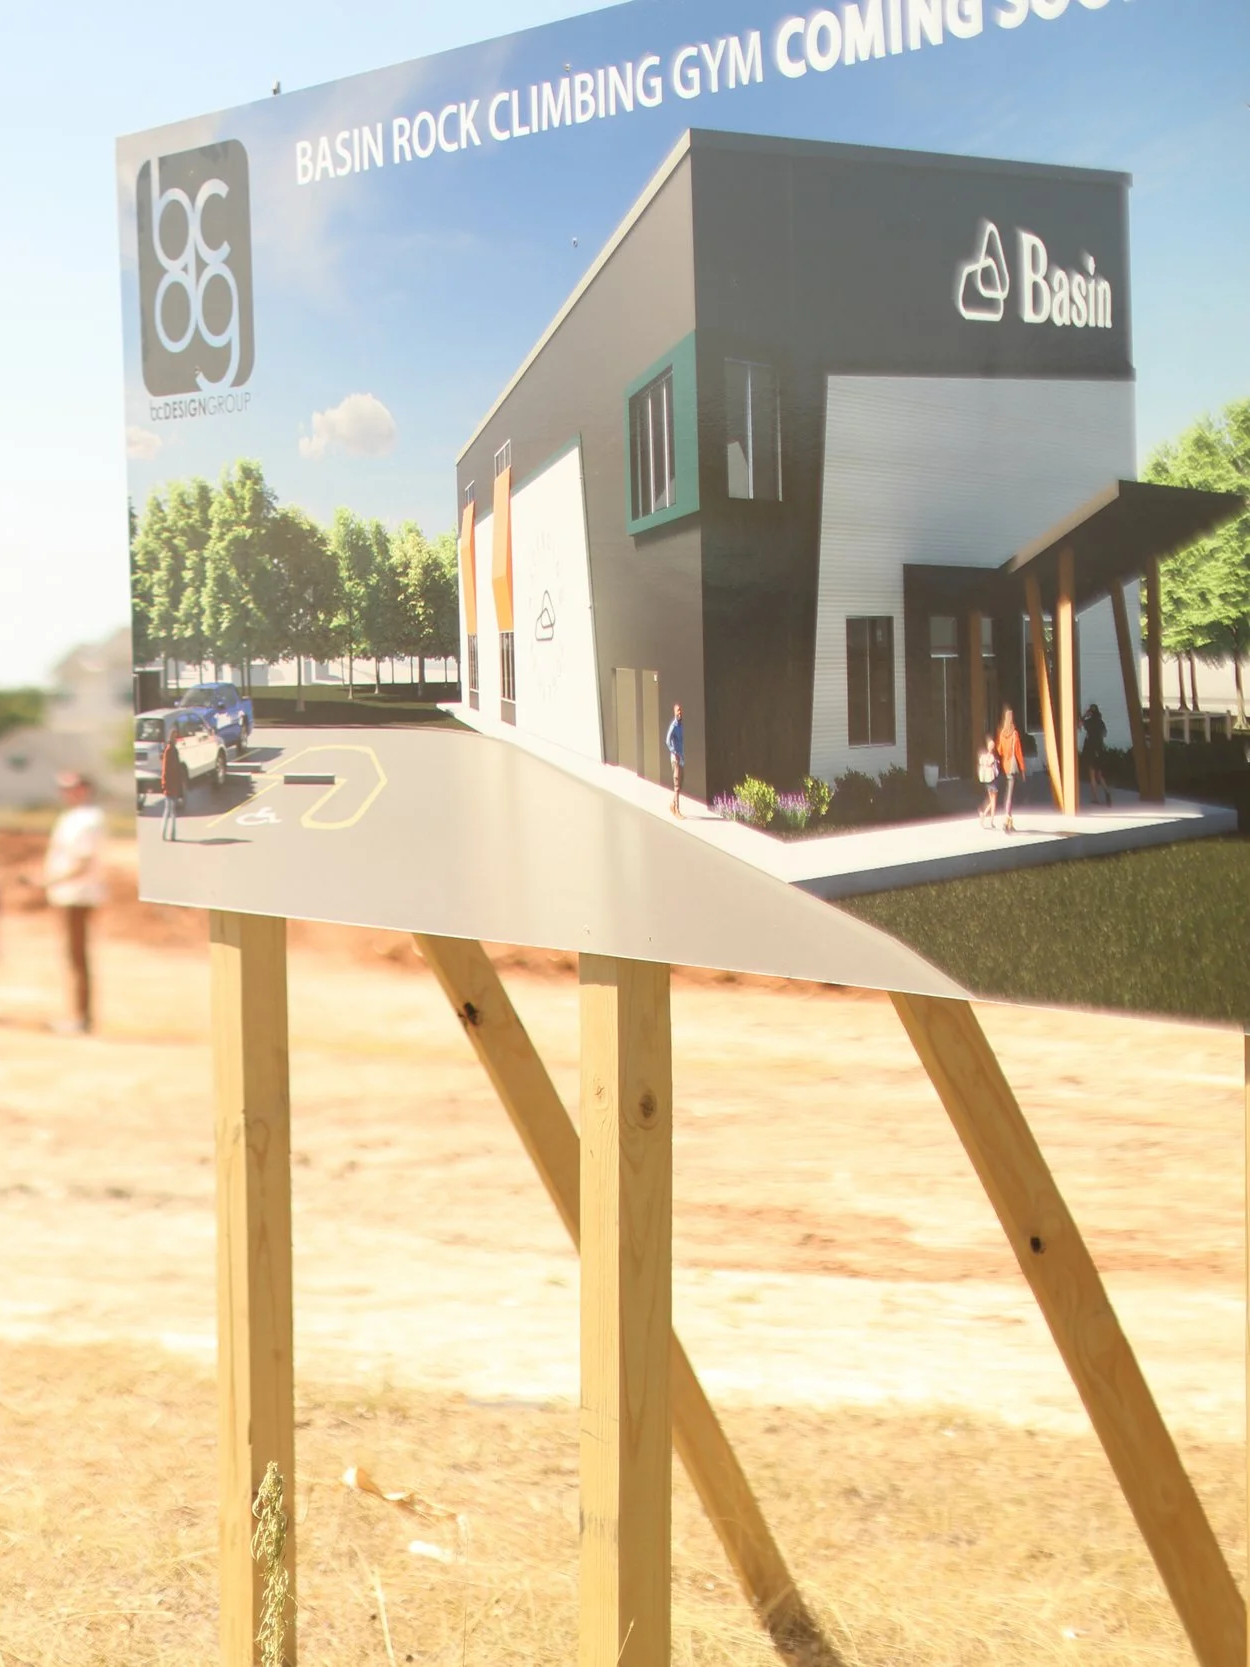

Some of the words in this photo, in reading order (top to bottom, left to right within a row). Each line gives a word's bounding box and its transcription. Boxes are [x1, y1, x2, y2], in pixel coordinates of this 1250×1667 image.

[295, 122, 384, 186] BASIN
[392, 99, 482, 164] ROCK
[489, 55, 663, 141] CLIMBING
[672, 30, 765, 100] GYM
[775, 0, 984, 79] COMING
[1018, 228, 1113, 329] Basin
